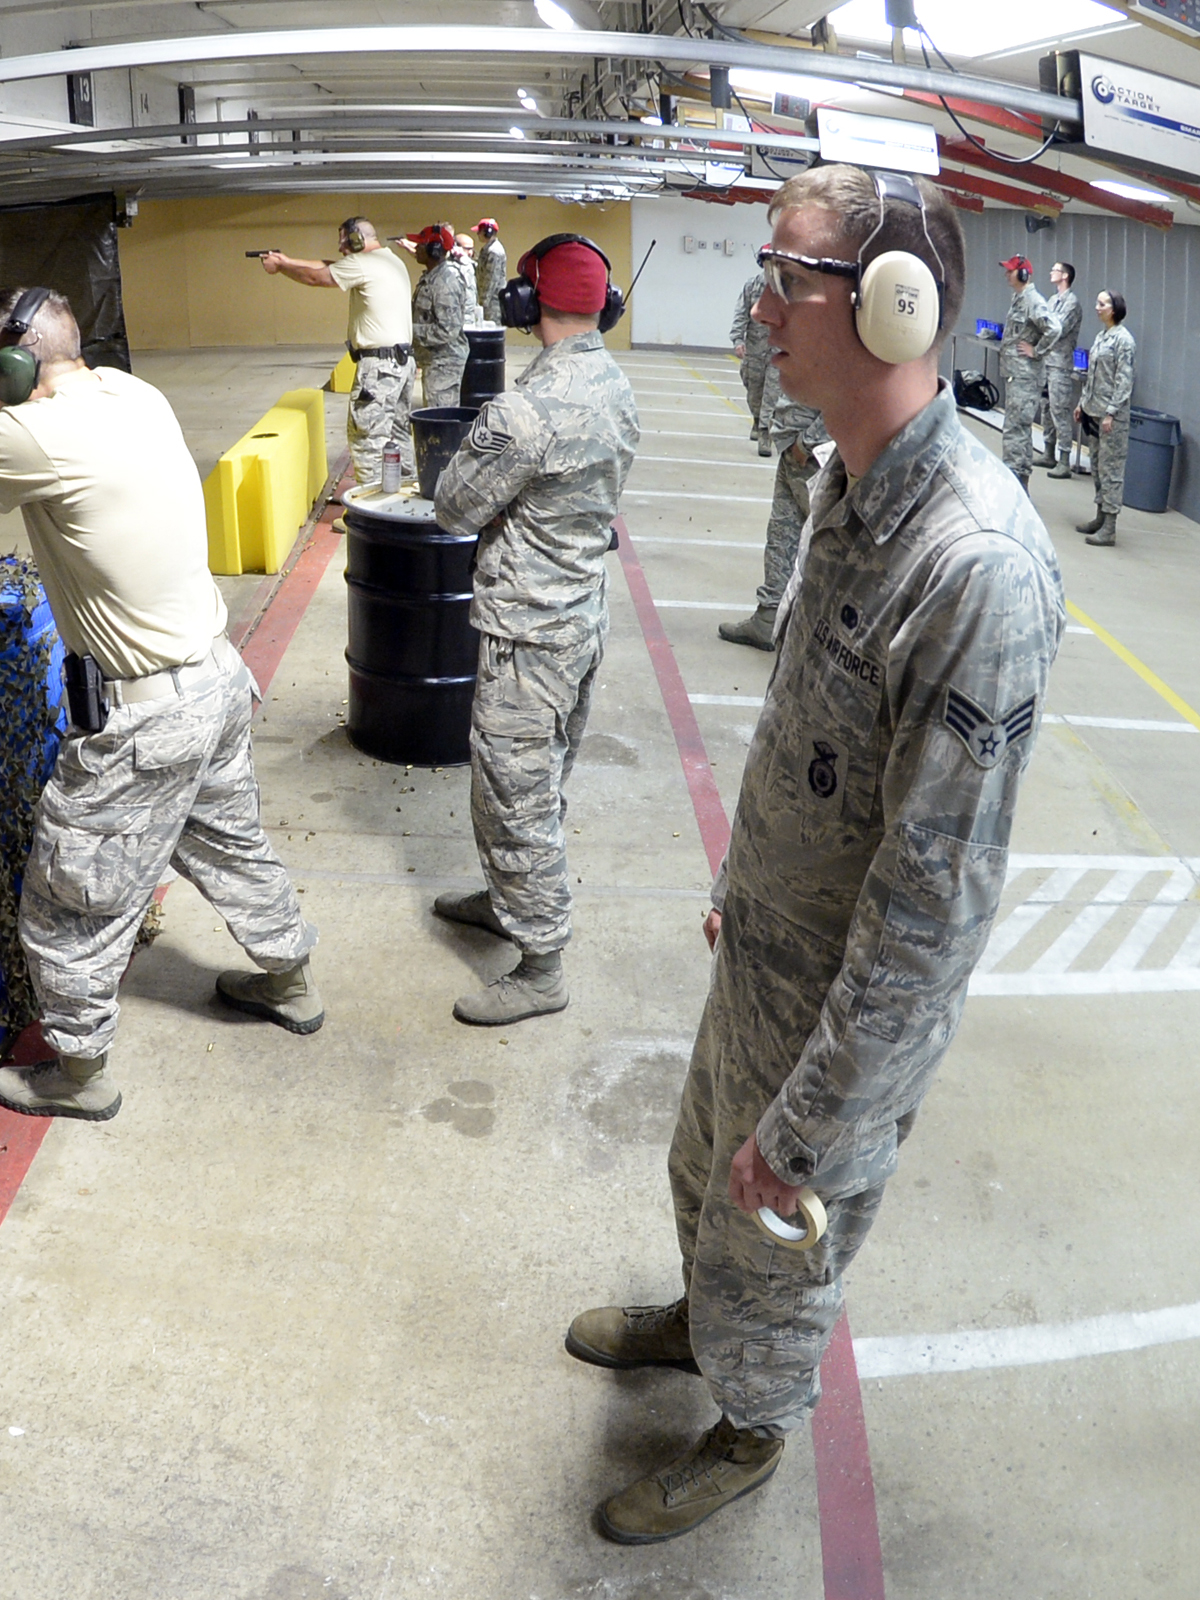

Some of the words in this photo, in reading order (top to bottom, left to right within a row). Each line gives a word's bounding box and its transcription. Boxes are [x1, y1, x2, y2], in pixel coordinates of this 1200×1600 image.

[79, 77, 90, 102] 13
[1109, 85, 1154, 103] ACTION
[140, 92, 149, 114] 14
[1116, 95, 1161, 113] TARGET
[897, 298, 915, 315] 95
[837, 645, 880, 686] FORCE
